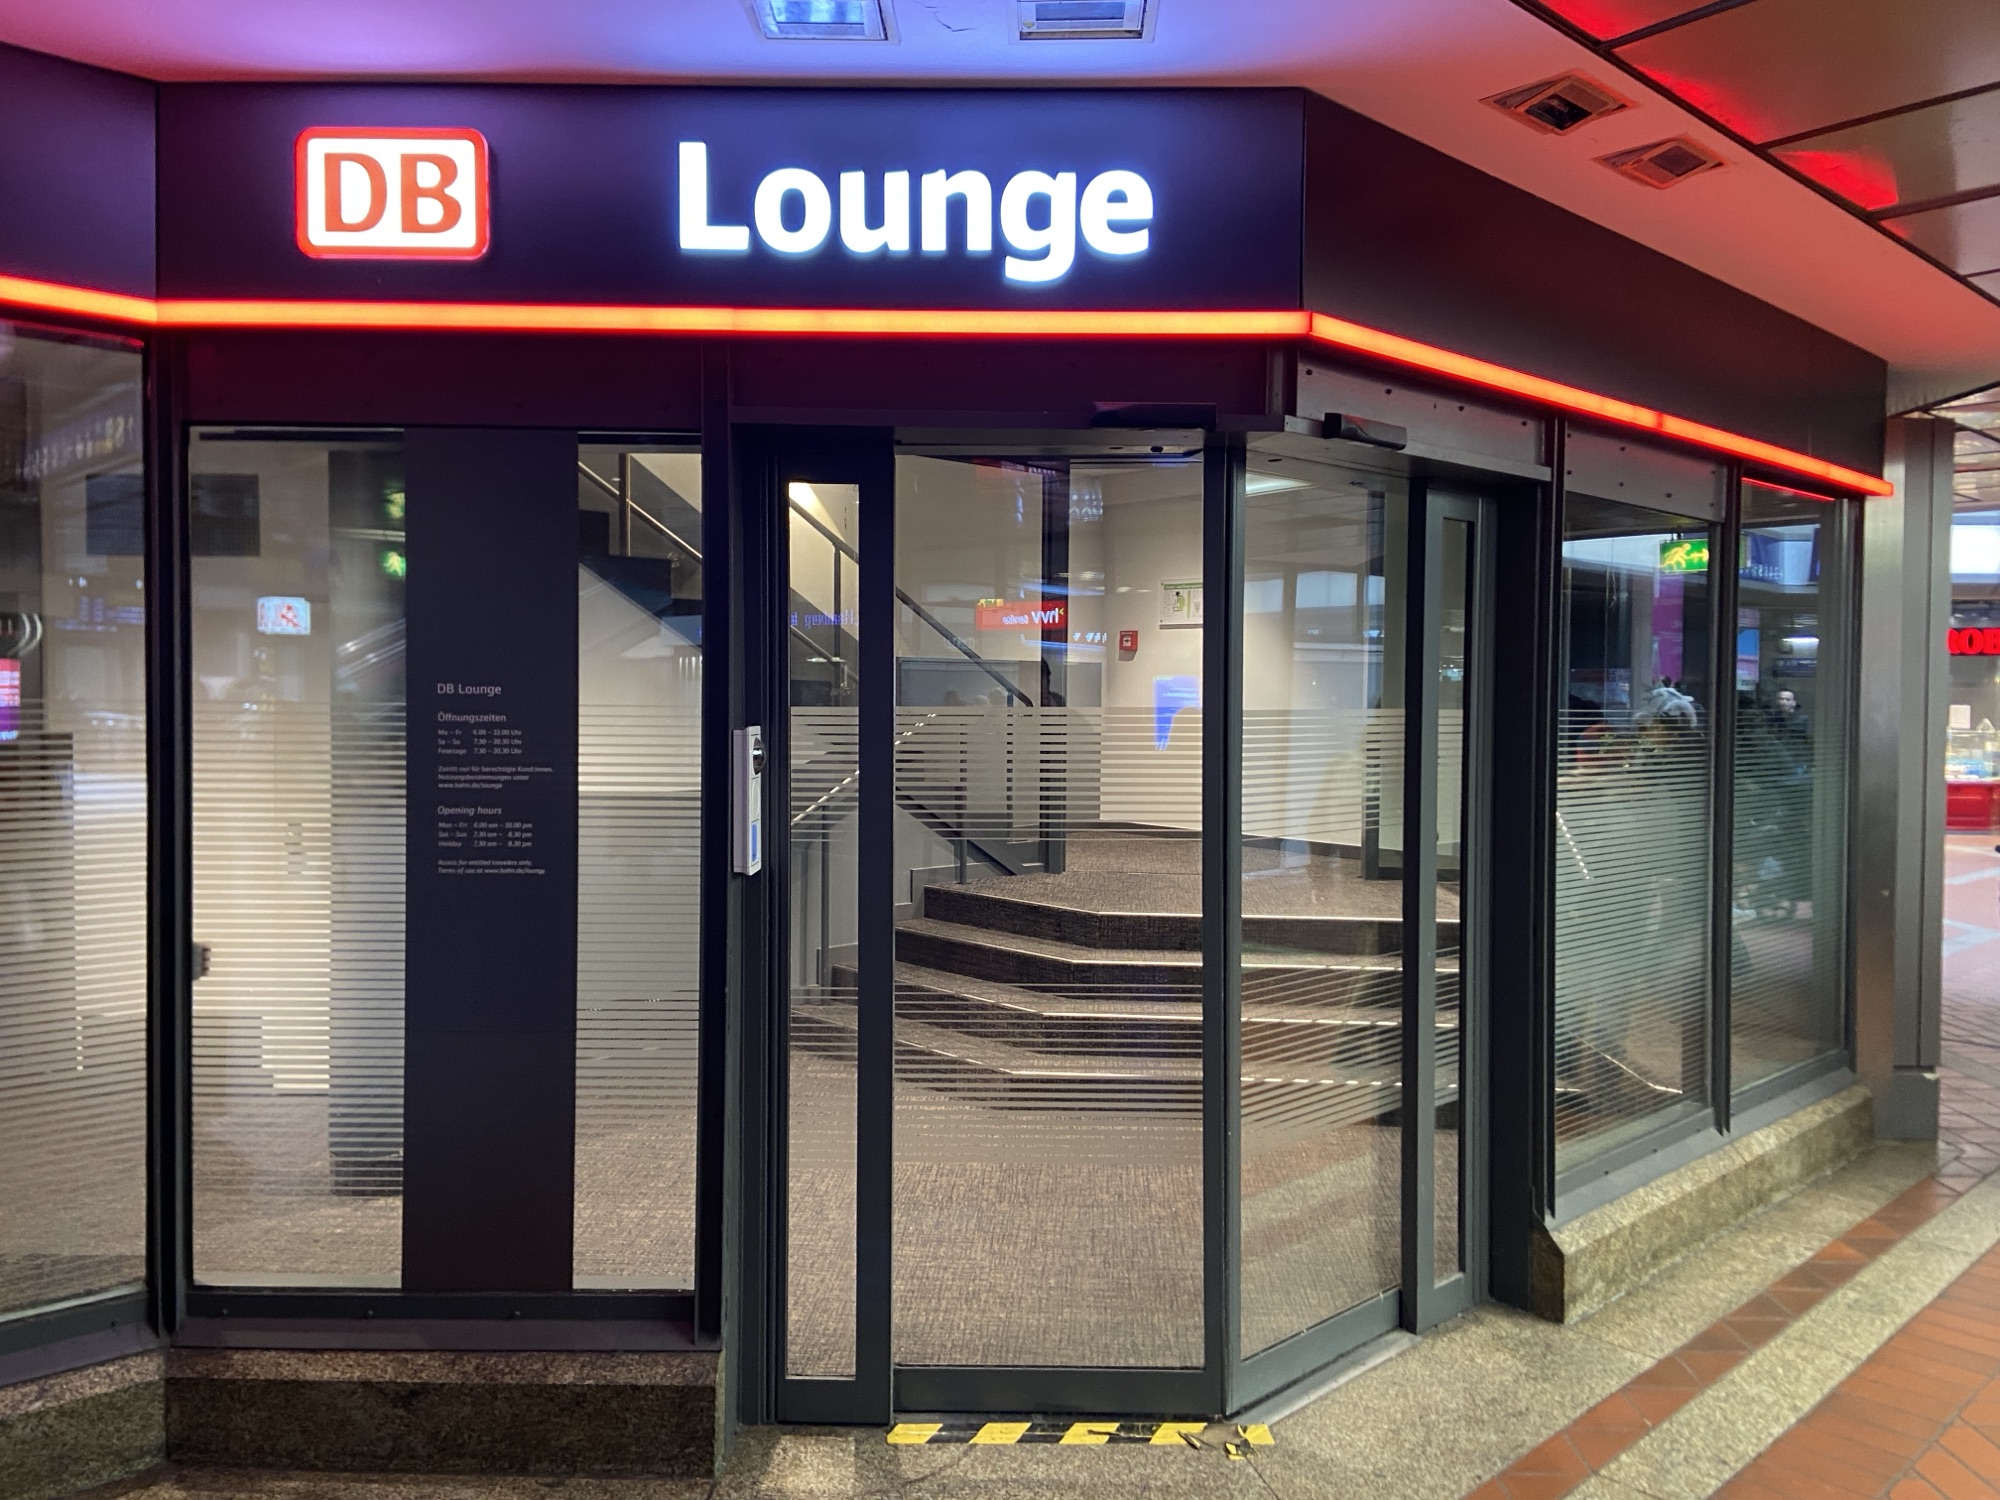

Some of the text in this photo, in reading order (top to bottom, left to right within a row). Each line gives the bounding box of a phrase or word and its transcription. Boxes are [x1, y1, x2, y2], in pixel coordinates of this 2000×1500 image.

[322, 140, 1155, 283] DB Lounge
[438, 683, 502, 697] DB Lounge
[438, 711, 507, 724] Öffnungszeiten
[437, 805, 502, 816] Opening hours
